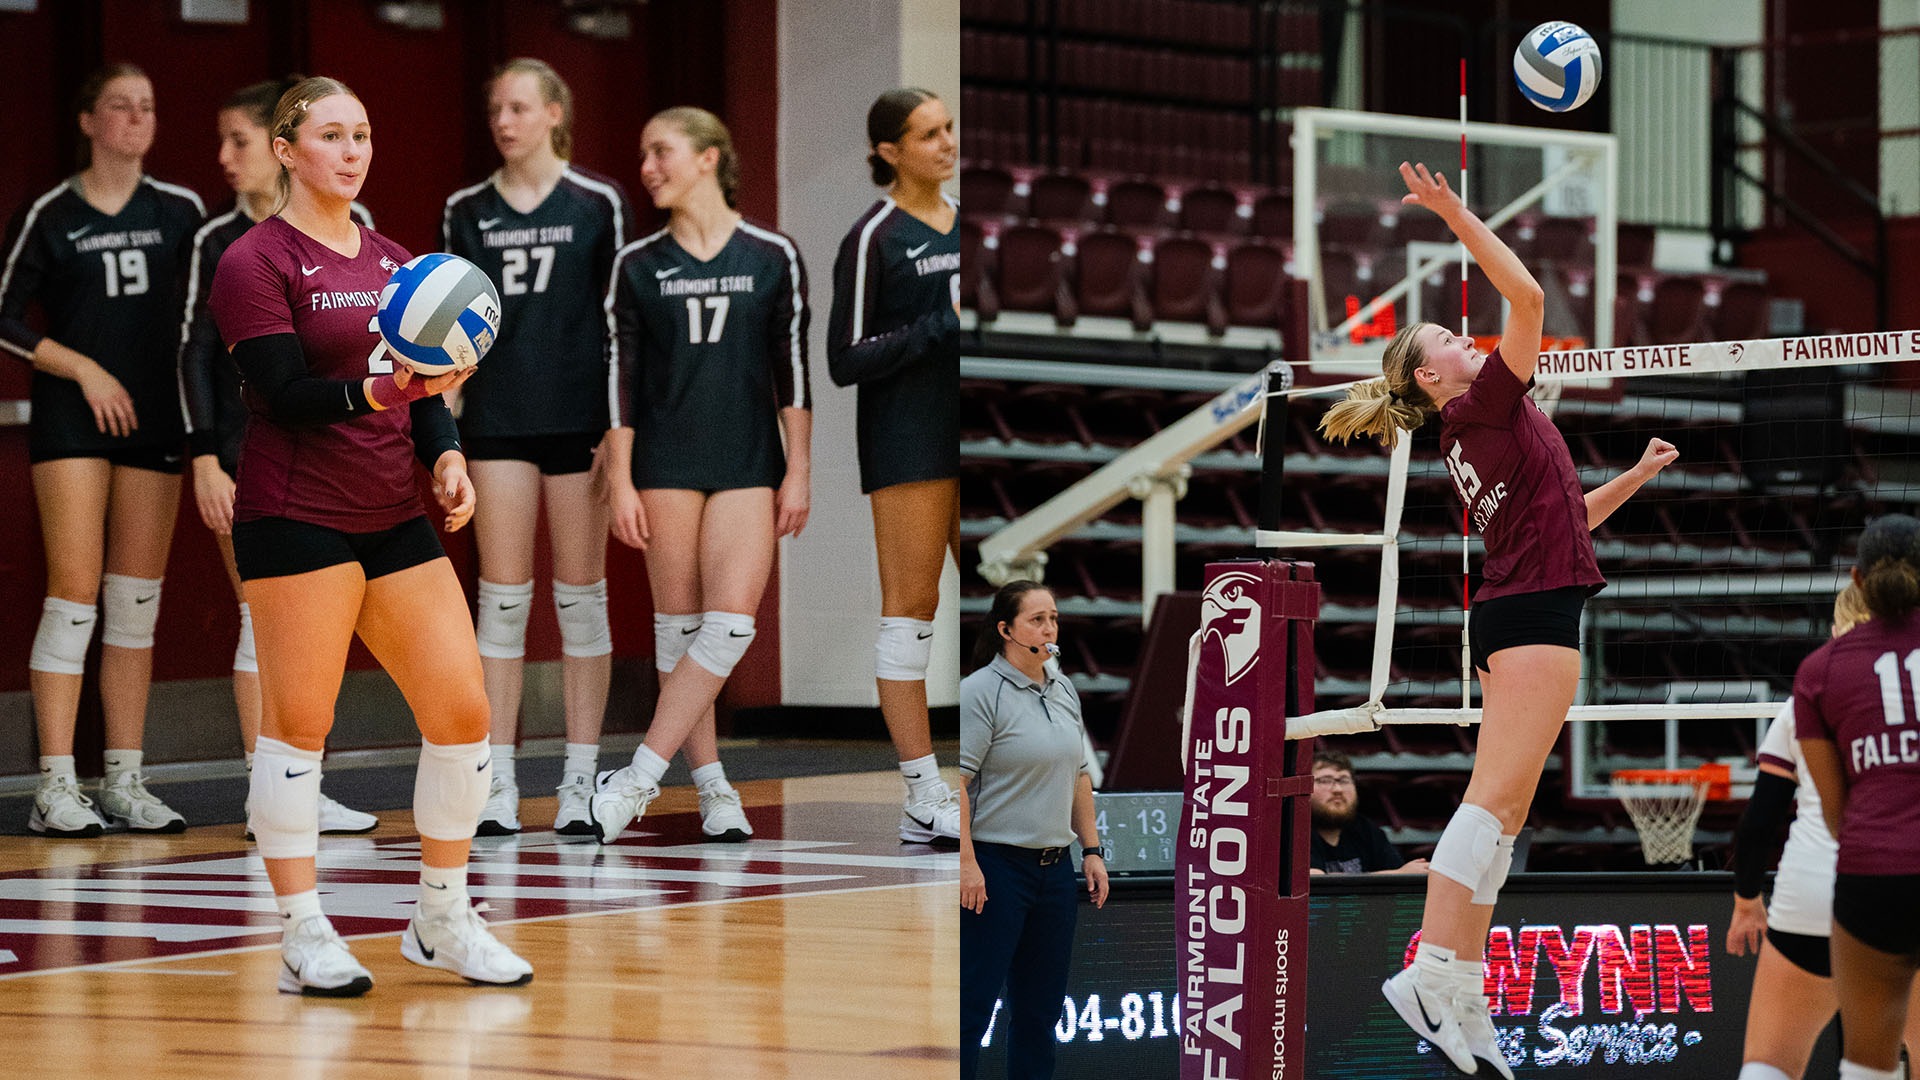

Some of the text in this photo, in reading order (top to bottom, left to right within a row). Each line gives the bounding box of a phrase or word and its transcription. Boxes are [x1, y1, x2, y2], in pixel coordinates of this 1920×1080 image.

[539, 225, 573, 243] STATE
[101, 248, 149, 298] 19
[502, 245, 556, 296] 27
[660, 275, 755, 296] FAIRMONT STATE
[686, 296, 731, 344] 17
[1538, 346, 1692, 374] RMONT STATE
[1783, 333, 1903, 361] FAIRMONT
[1874, 648, 1920, 726] 11
[1851, 730, 1920, 775] FALC
[1136, 808, 1168, 835] 13
[1163, 847, 1170, 860] 1
[1185, 739, 1213, 1056] FAIRMONT STATE
[1203, 707, 1251, 1080] FALCONS
[1404, 924, 1713, 1016] WYNN
[1272, 928, 1289, 1080] sports imports
[1534, 1001, 1679, 1067] Service
